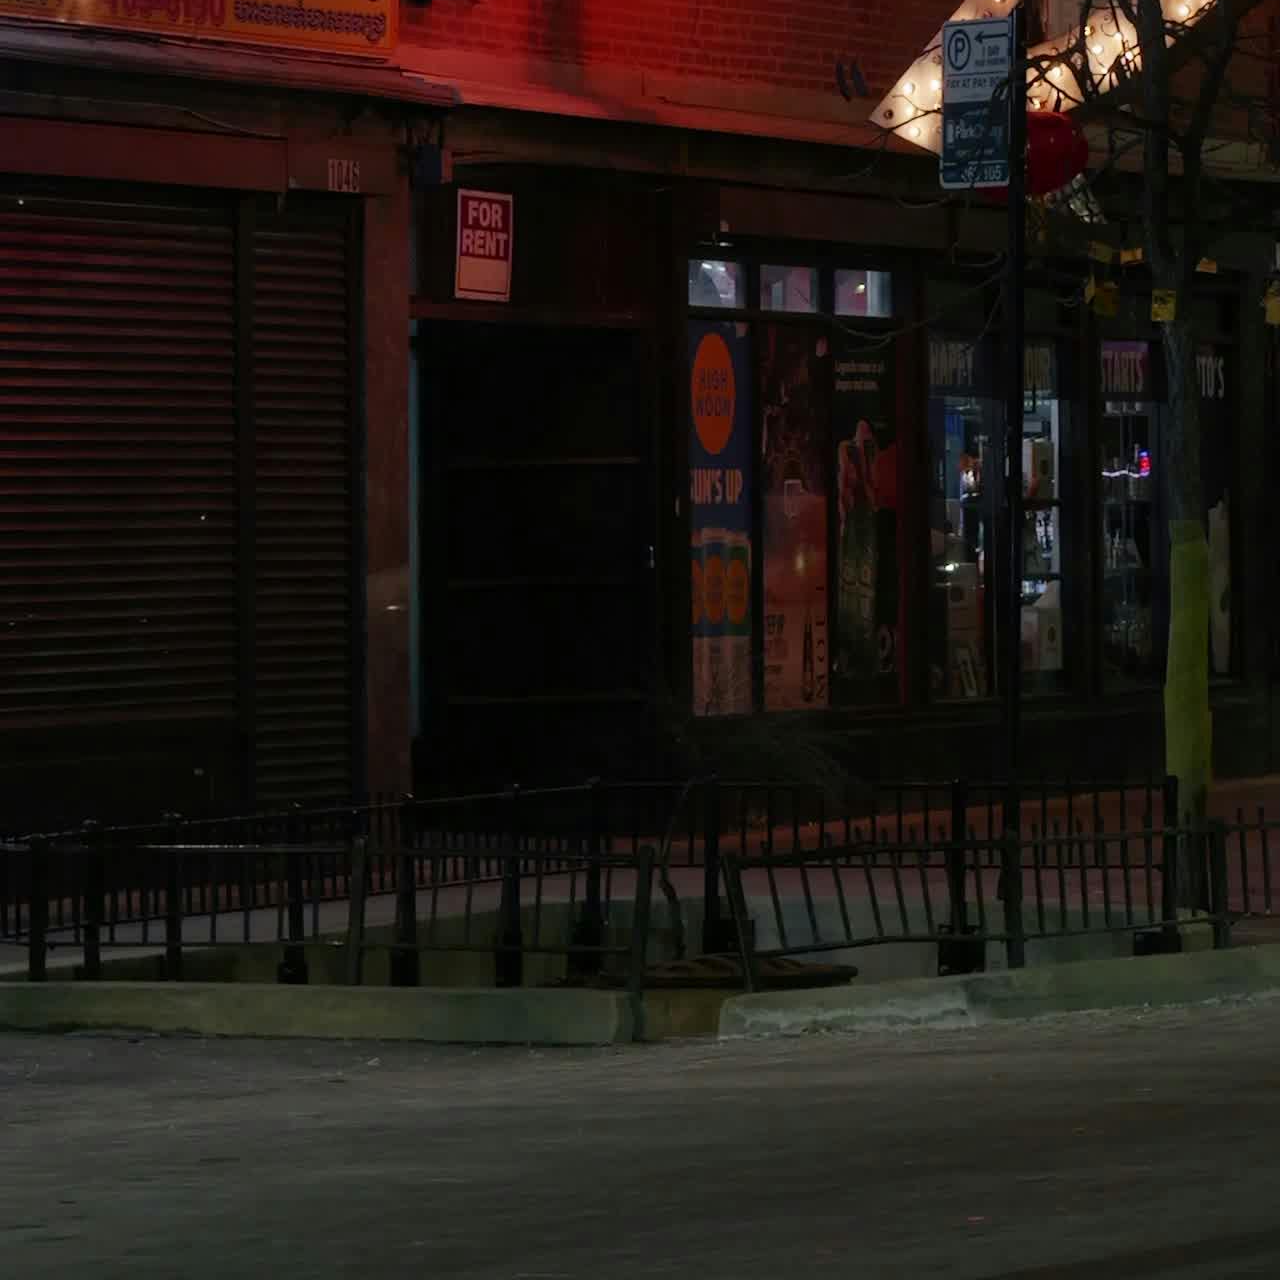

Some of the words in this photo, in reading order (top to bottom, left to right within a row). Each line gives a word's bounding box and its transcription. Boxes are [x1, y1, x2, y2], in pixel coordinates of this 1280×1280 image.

[468, 200, 503, 230] FOR
[462, 229, 509, 258] RENT
[725, 467, 743, 505] UP
